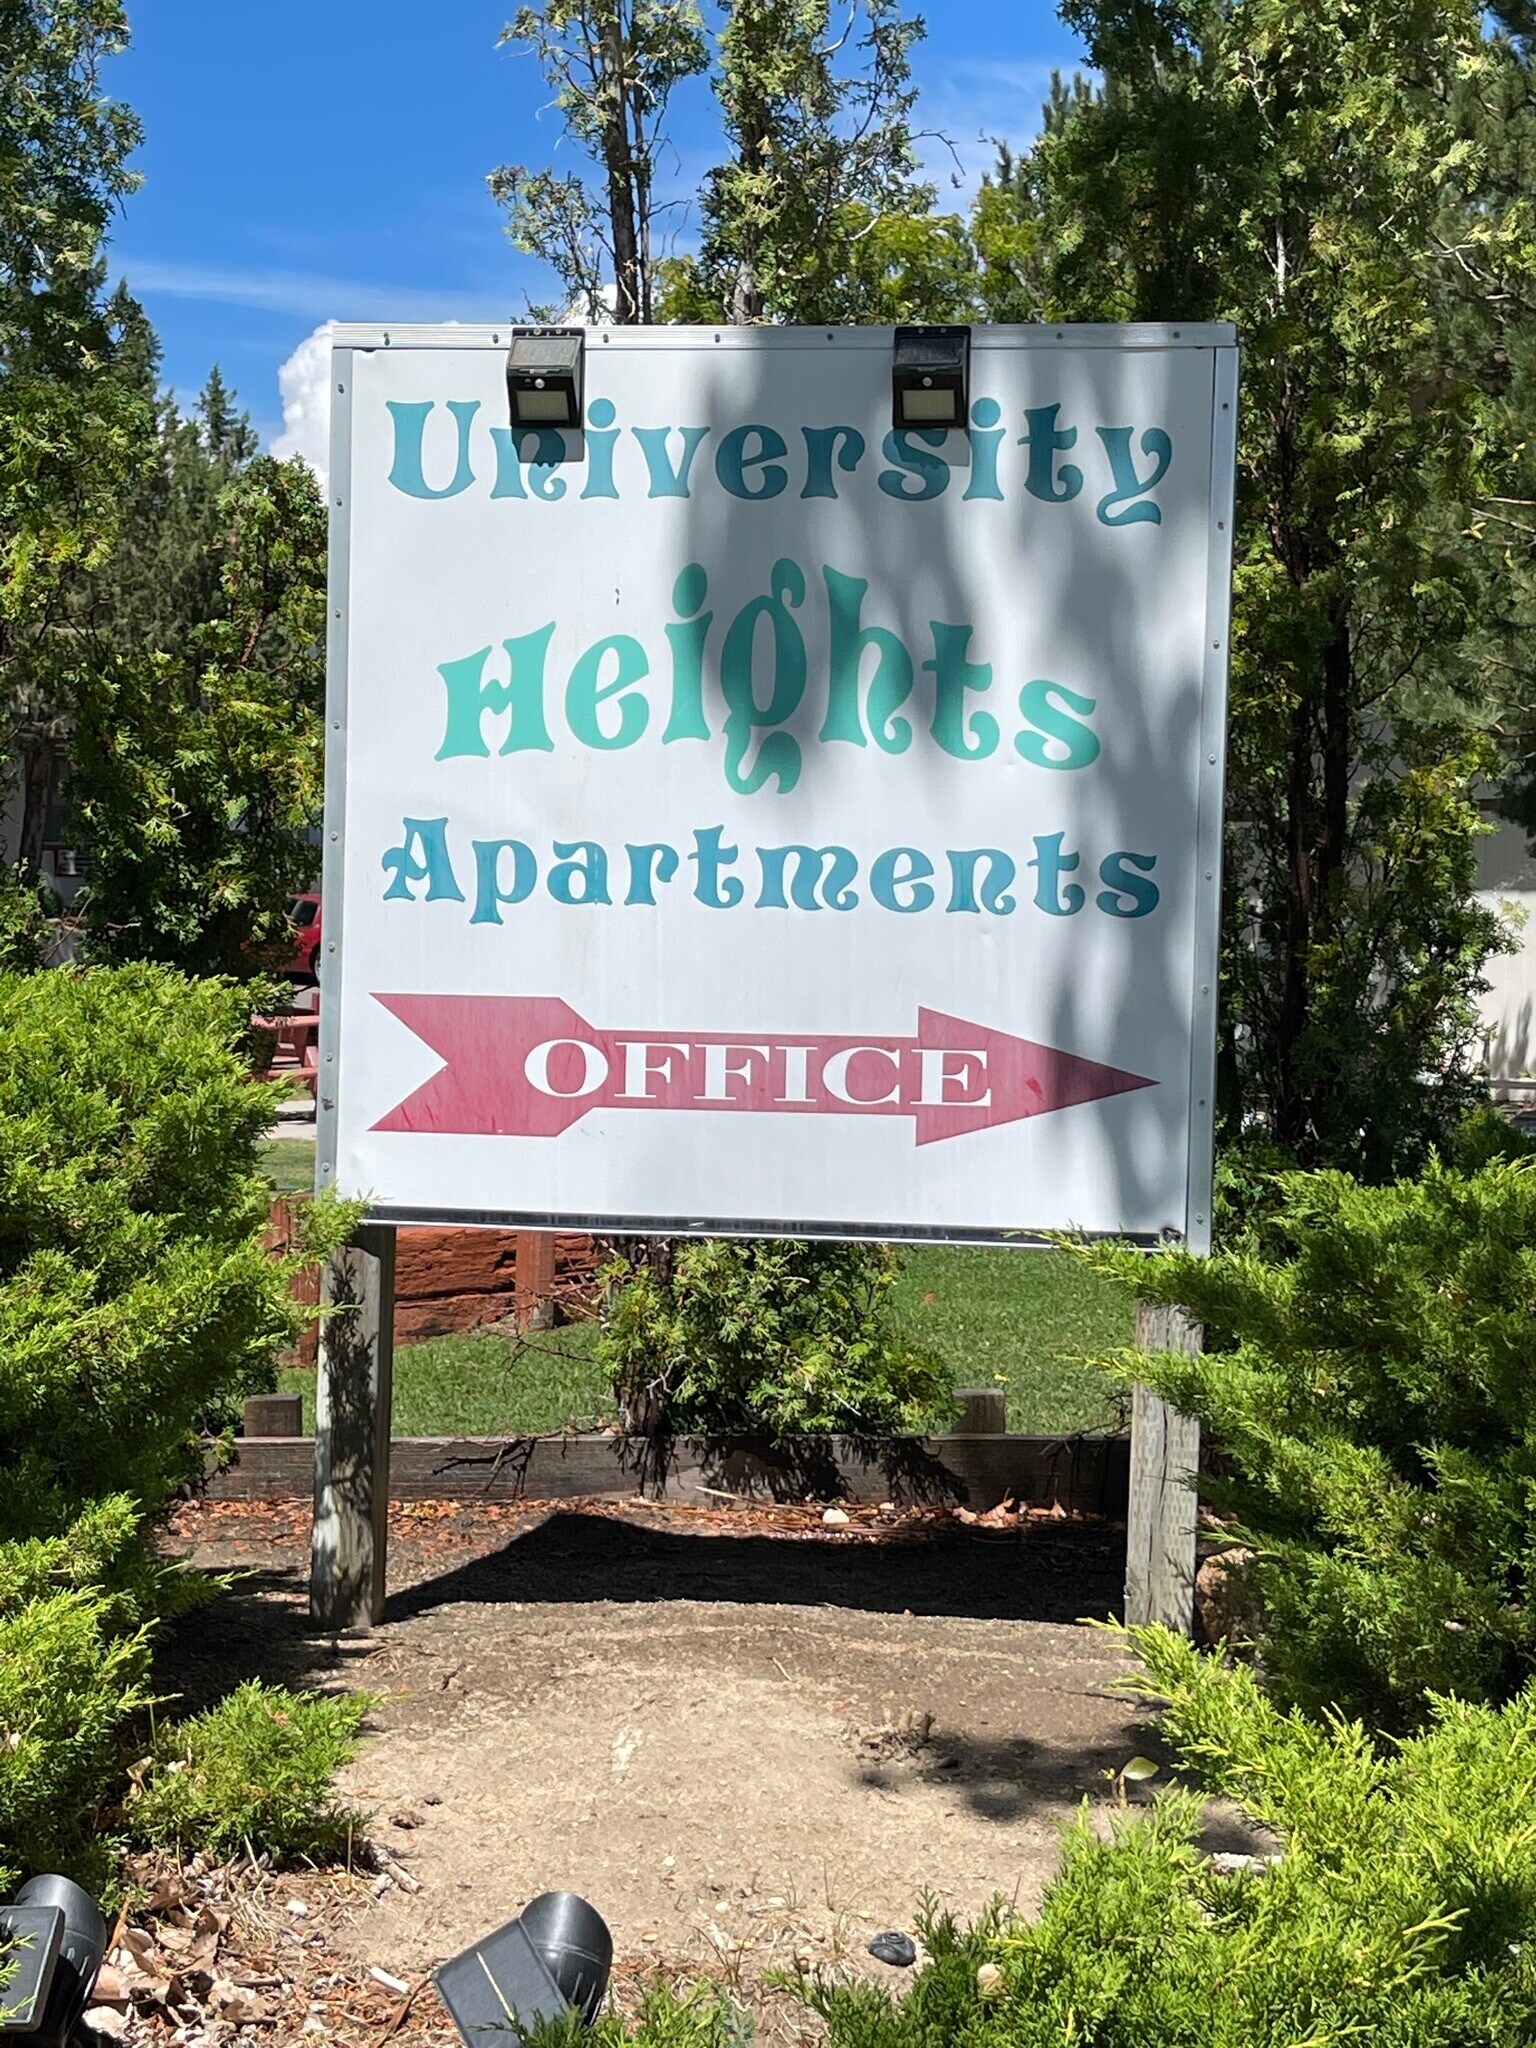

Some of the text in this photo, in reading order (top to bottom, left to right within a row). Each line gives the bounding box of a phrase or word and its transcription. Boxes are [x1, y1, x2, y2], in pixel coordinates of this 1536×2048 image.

[385, 397, 1173, 527] University
[434, 557, 1102, 796] Heights
[381, 816, 1161, 926] Apartments
[524, 1038, 993, 1108] OFFICE
